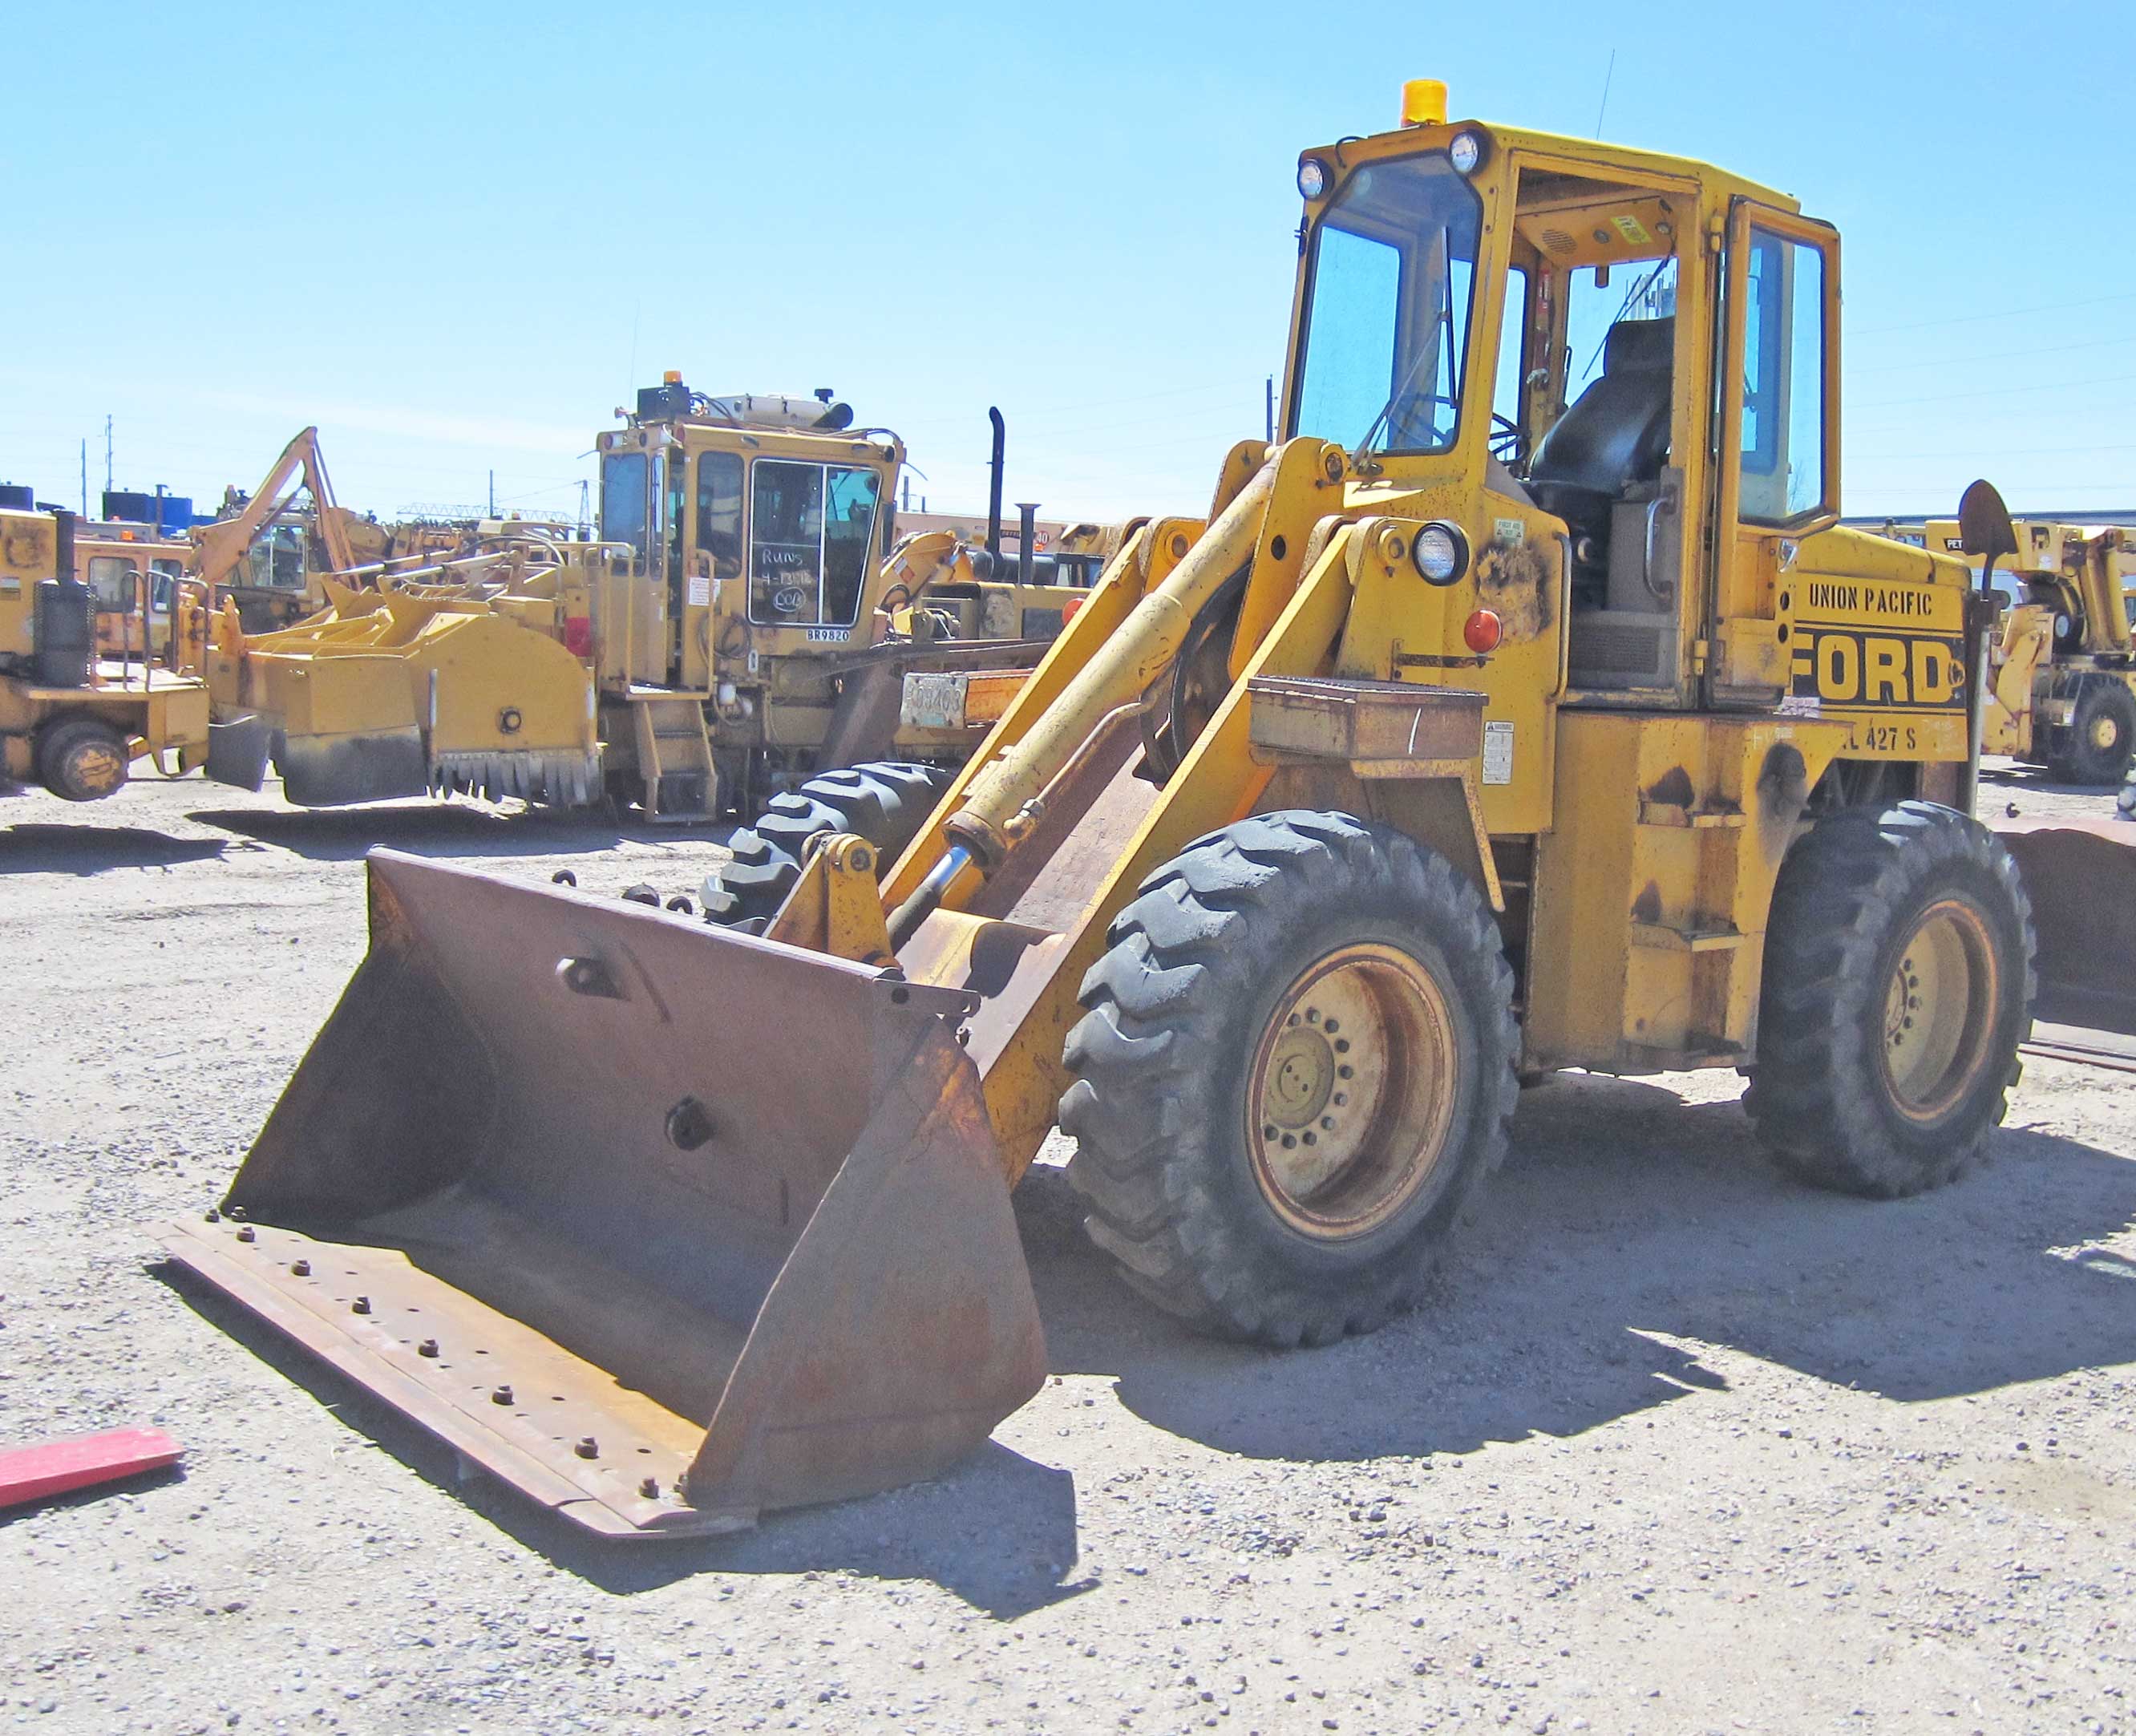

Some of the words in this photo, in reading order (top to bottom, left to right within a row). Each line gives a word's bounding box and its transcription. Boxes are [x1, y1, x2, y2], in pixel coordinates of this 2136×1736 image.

[1038, 532, 1048, 544] 40
[1810, 583, 1858, 609] UNION
[1865, 588, 1932, 615] PACIFIC
[1783, 633, 1953, 703] FORD
[1866, 727, 1898, 751] 427
[1906, 727, 1916, 751] S
